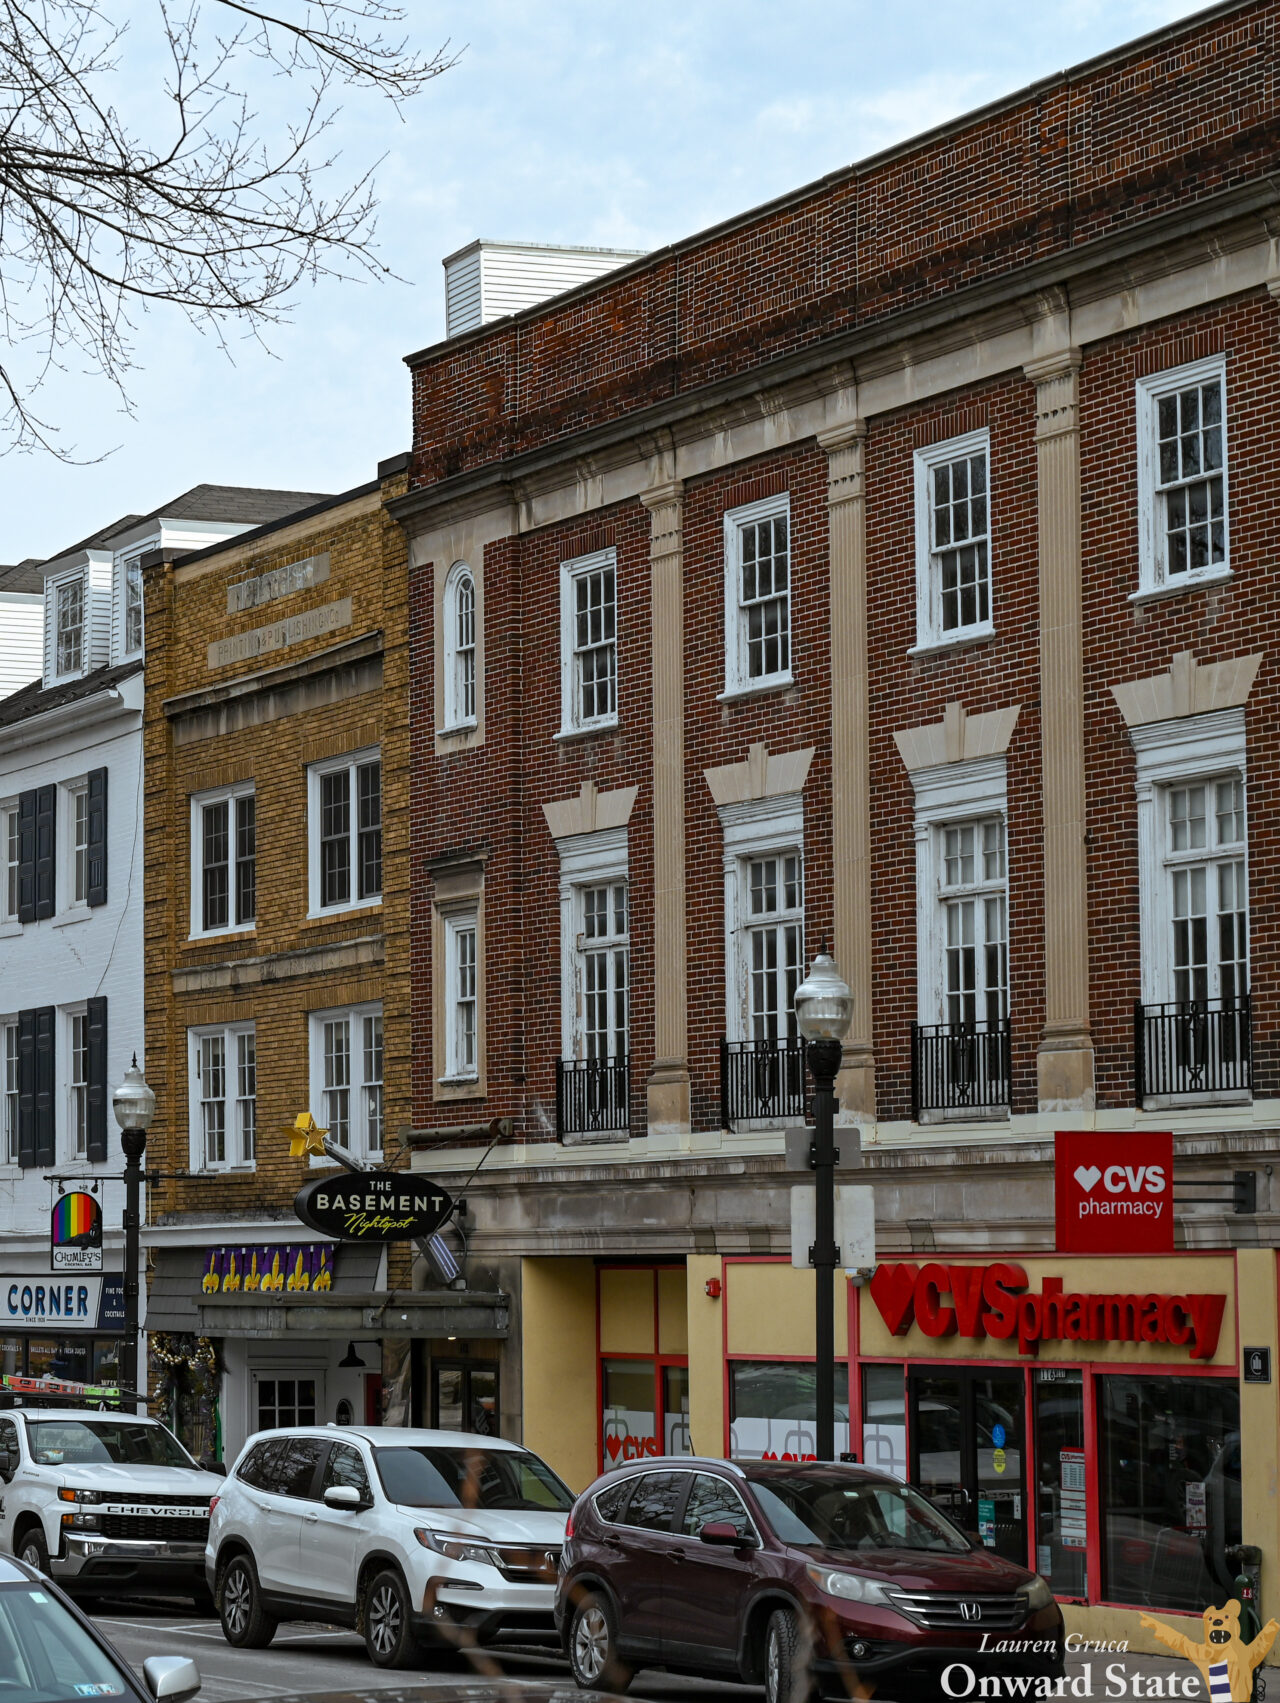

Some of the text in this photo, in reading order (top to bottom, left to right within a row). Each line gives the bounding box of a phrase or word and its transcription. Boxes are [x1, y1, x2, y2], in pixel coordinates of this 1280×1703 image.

[370, 1181, 392, 1191] THE
[1103, 1165, 1166, 1194] CVS
[317, 1194, 443, 1211] BASEMENT
[1079, 1197, 1164, 1218] pharmacy
[344, 1212, 418, 1235] Nightspot
[8, 1284, 88, 1316] CORNER
[914, 1263, 1227, 1359] CVS pharmacy
[622, 1435, 656, 1460] CVS
[107, 1506, 210, 1517] CHEVROLE
